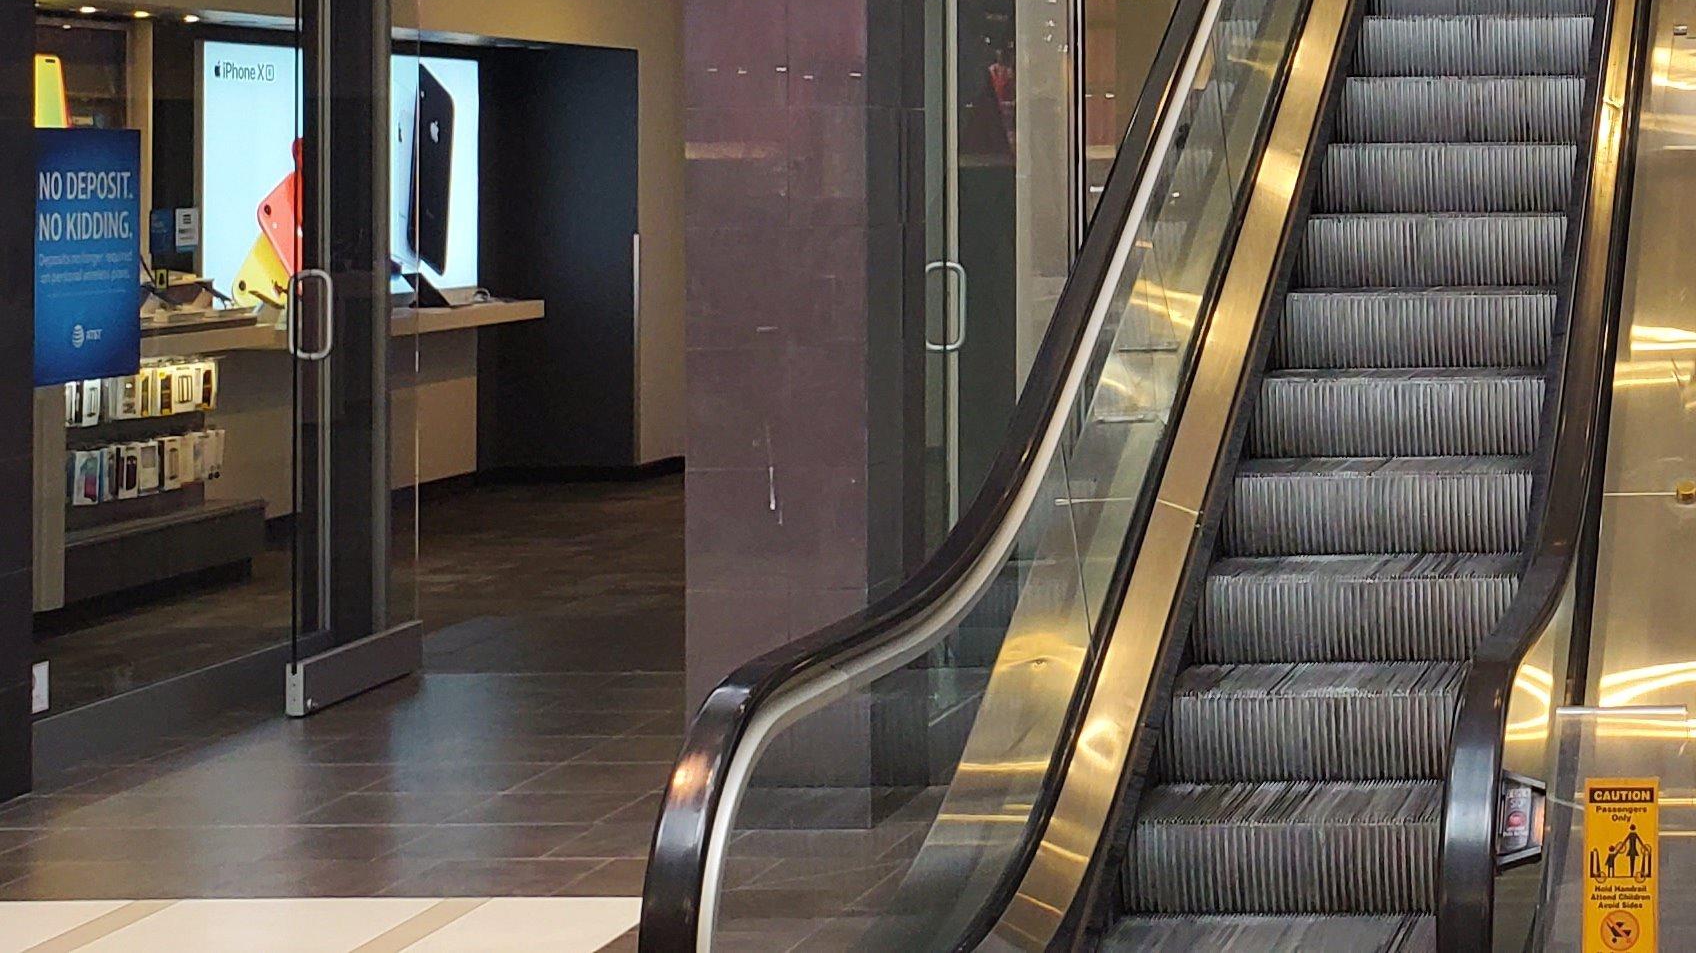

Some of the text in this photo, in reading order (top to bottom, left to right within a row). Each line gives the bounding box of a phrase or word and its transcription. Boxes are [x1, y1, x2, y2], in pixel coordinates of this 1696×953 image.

[223, 61, 256, 80] iPhone
[39, 171, 133, 201] NO DEPOSIT.
[39, 211, 133, 241] NO KIDDING.
[1593, 790, 1651, 801] CAUTION
[1596, 806, 1648, 814] Passengers
[1612, 814, 1632, 822] Only
[1618, 893, 1651, 901] Children
